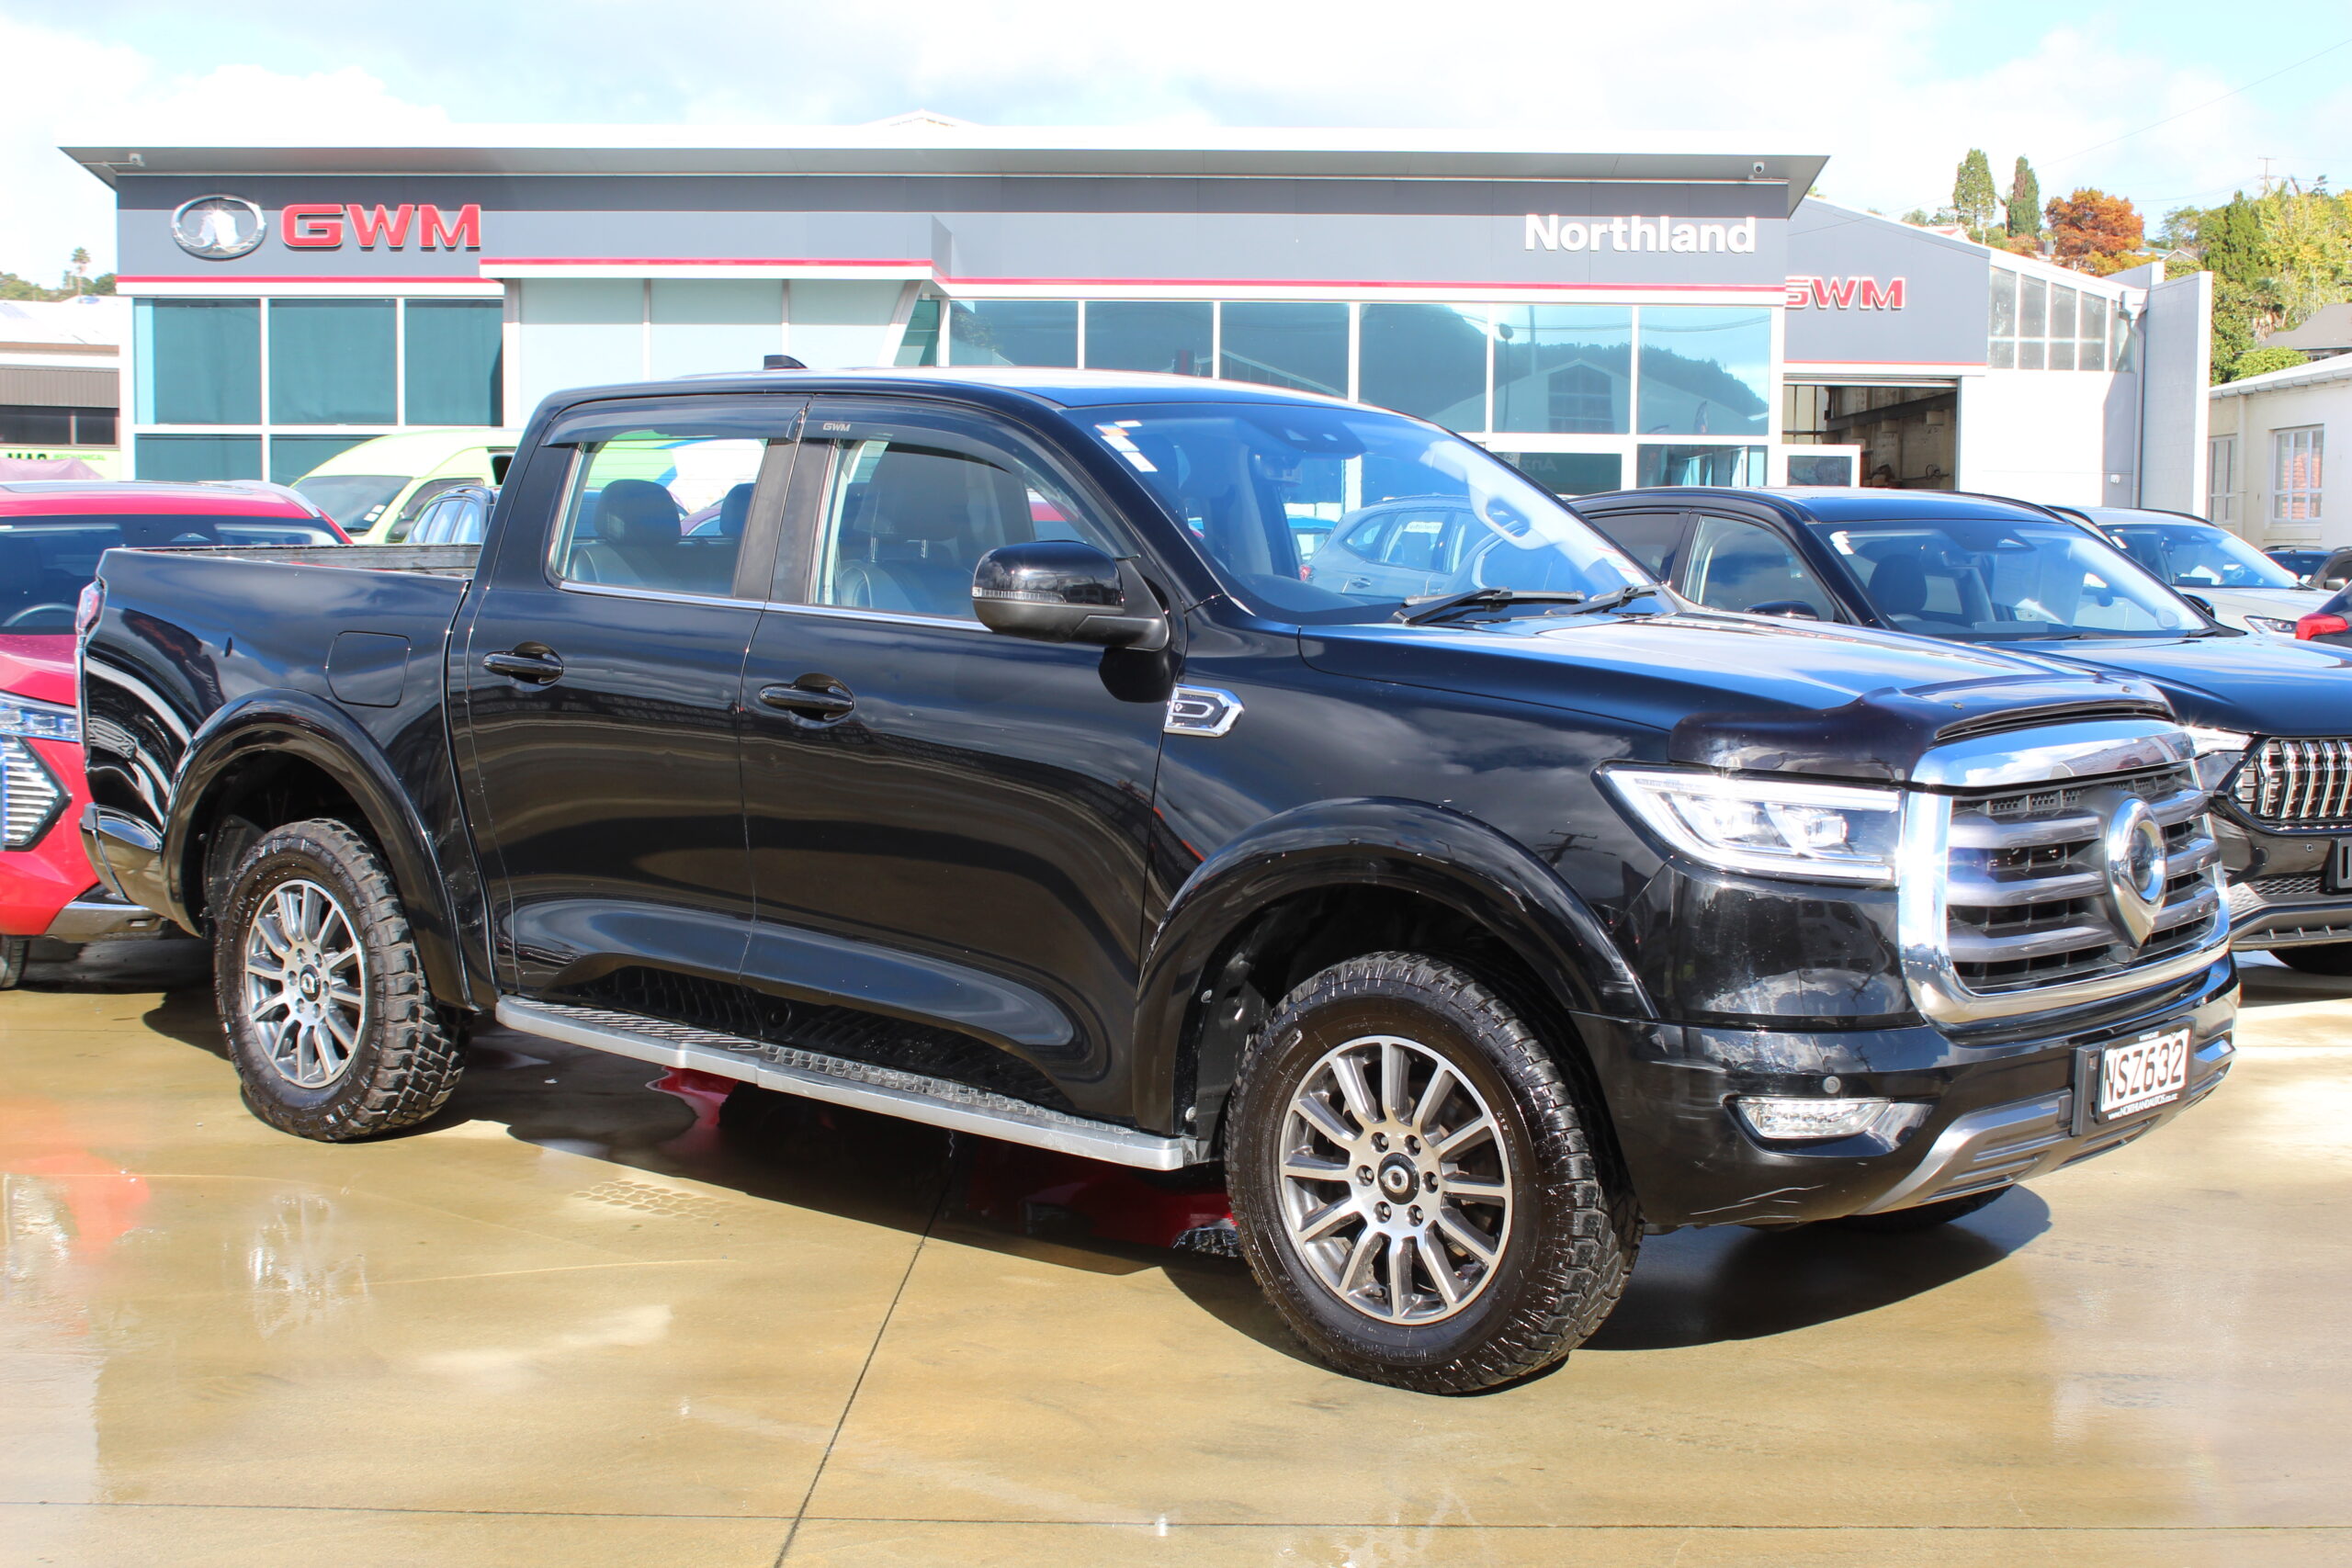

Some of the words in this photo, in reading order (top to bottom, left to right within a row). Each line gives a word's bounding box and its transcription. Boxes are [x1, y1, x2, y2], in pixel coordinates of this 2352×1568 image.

[281, 204, 481, 247] GWM
[1524, 214, 1756, 253] Northland
[823, 423, 851, 432] GWM
[2102, 1039, 2184, 1105] NSZ632
